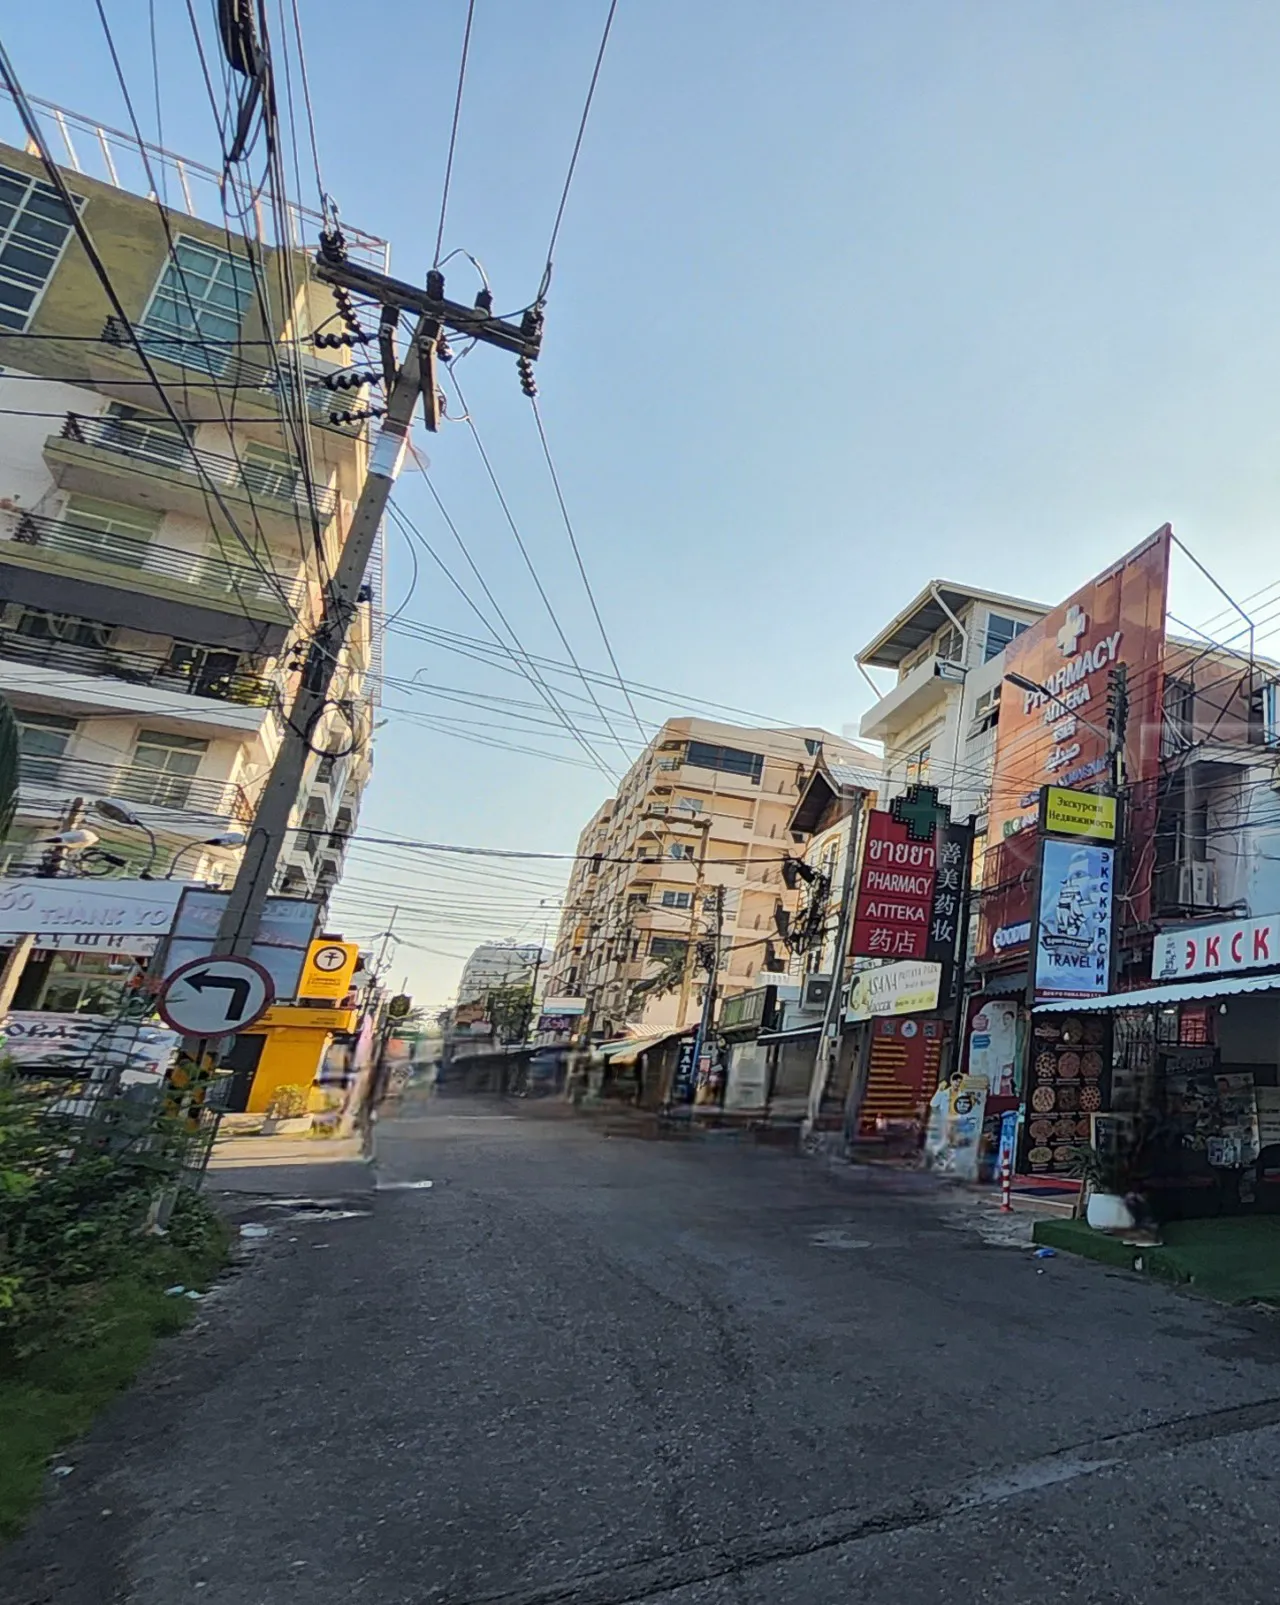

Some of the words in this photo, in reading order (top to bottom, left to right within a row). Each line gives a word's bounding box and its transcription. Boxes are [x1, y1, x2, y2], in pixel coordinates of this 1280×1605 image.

[1024, 631, 1121, 717] PHARMACY
[869, 839, 936, 868] ขายยา
[866, 870, 932, 896] PHARMACY
[865, 901, 925, 921] АПТЕКА
[1095, 851, 1109, 986] ЭКСКУРСИИ
[867, 927, 917, 953] 药店
[1047, 953, 1092, 969] TRAVEL
